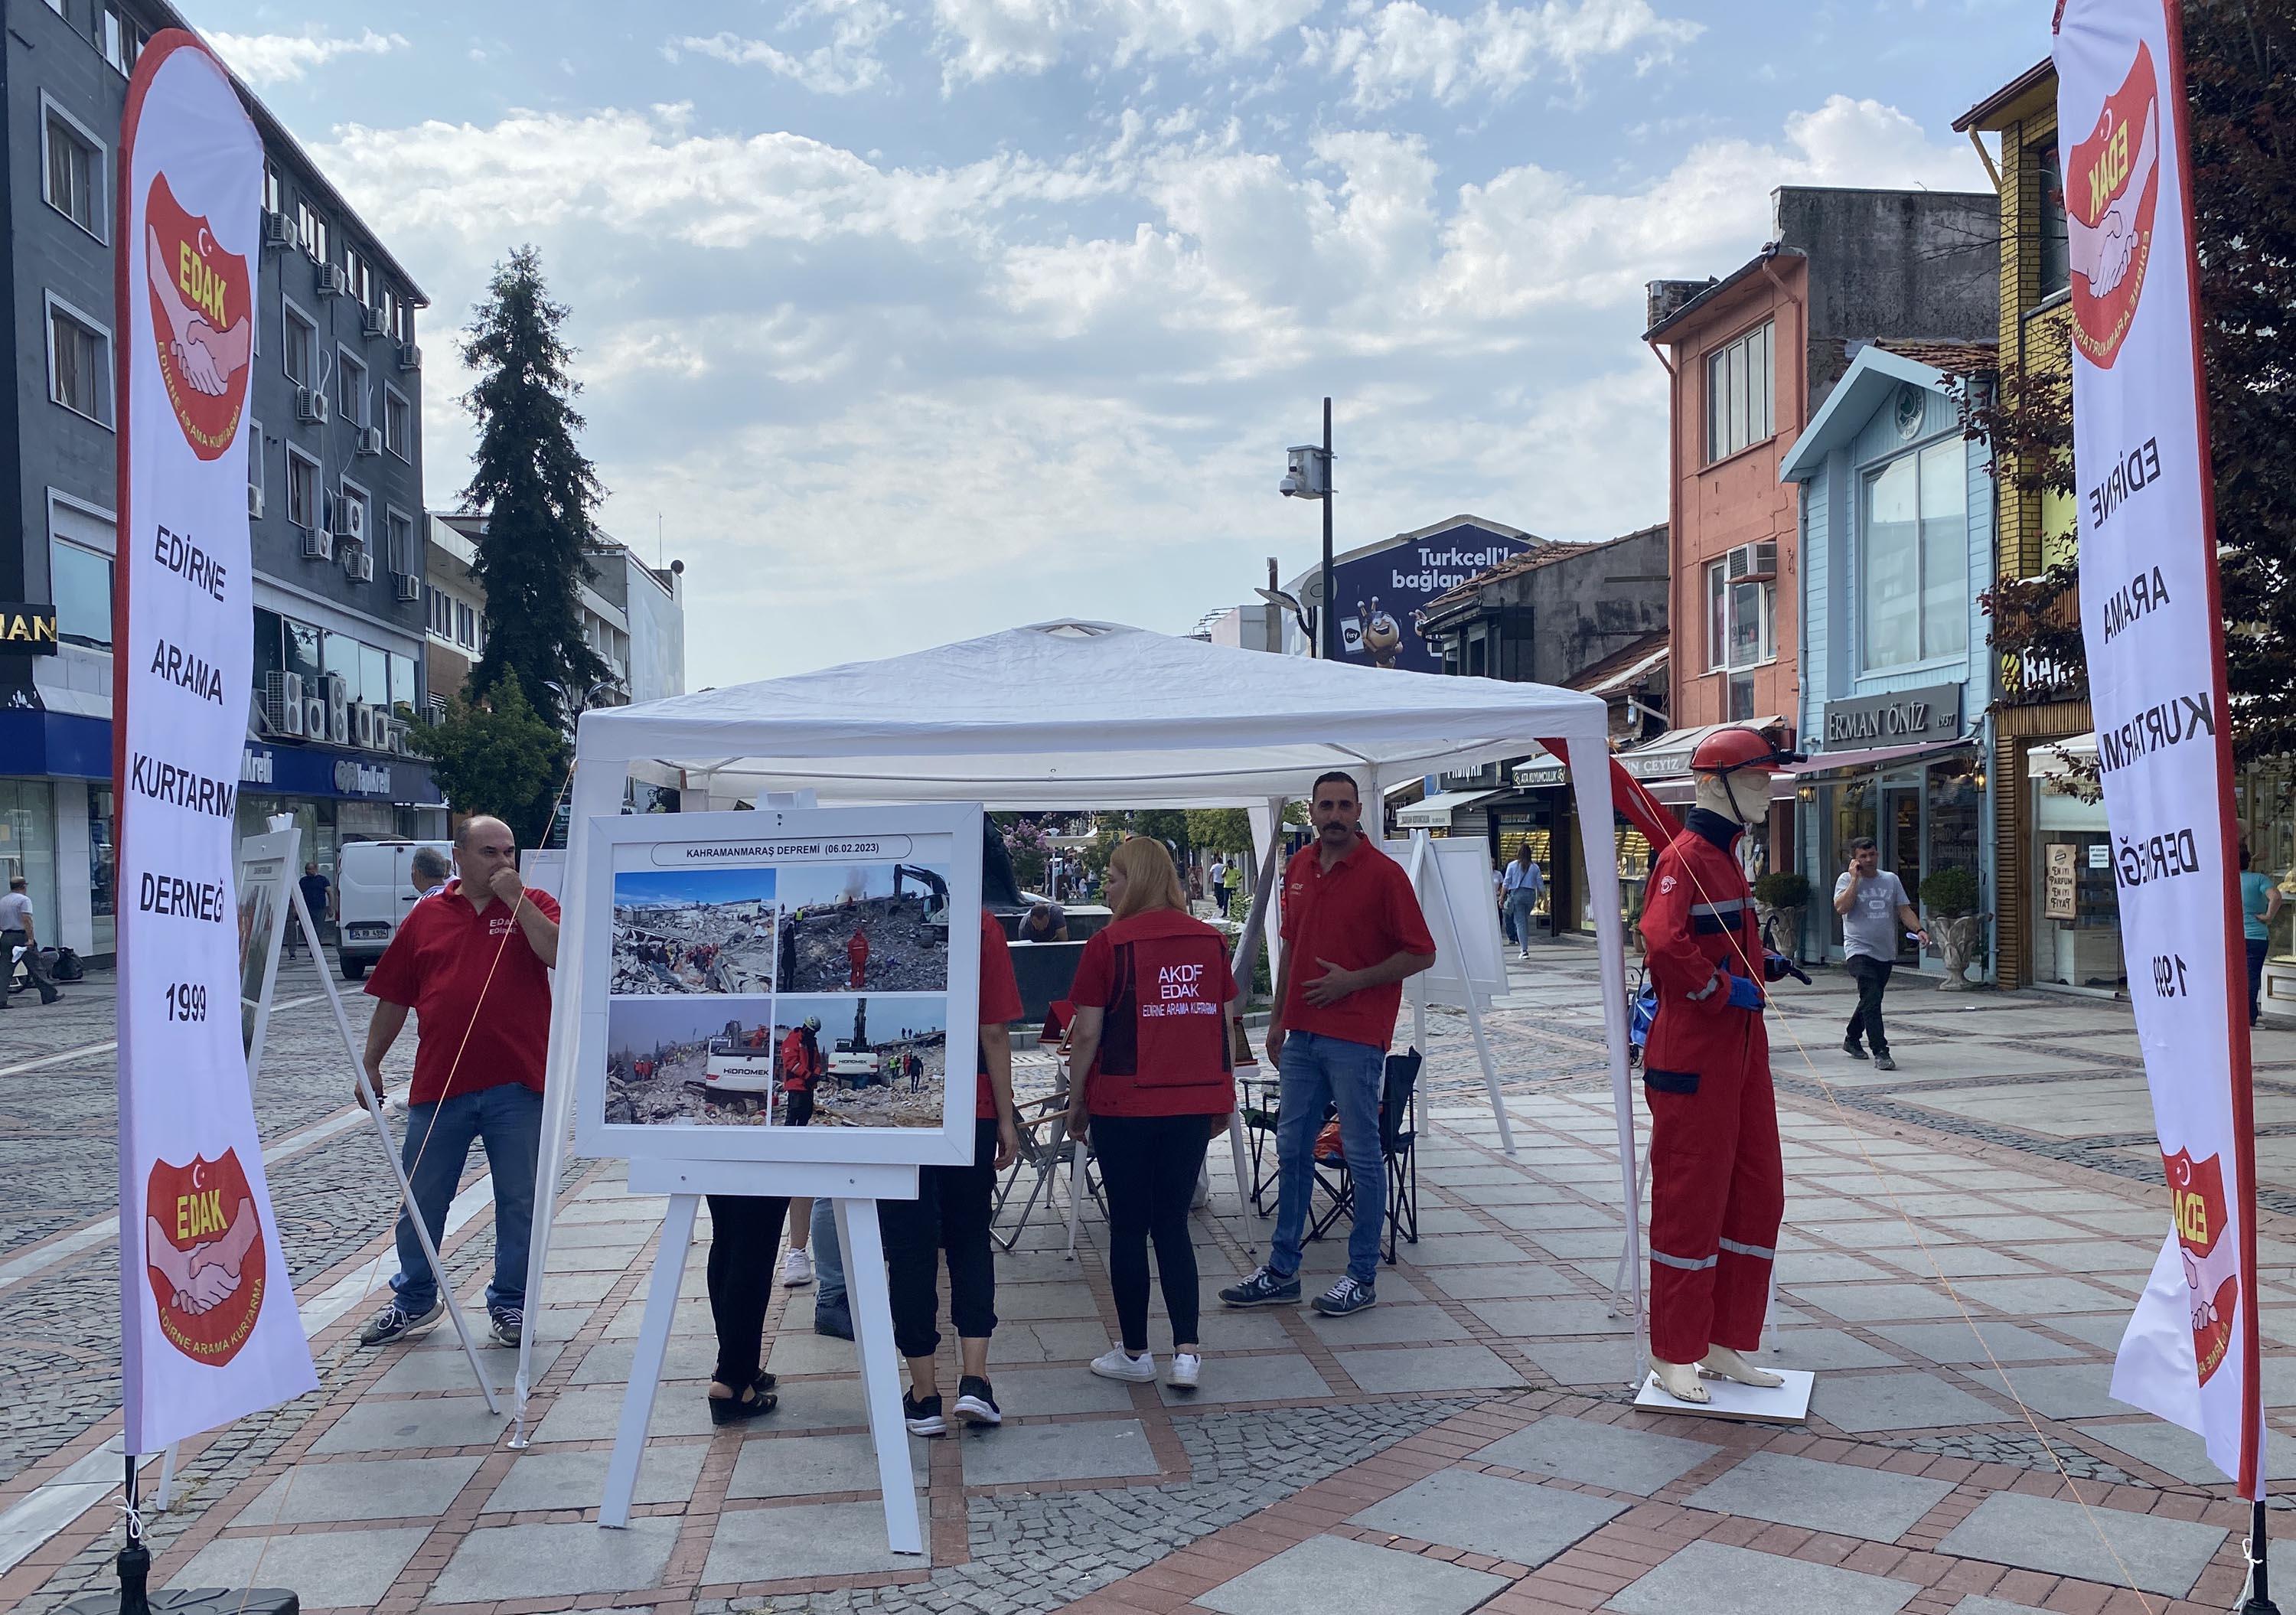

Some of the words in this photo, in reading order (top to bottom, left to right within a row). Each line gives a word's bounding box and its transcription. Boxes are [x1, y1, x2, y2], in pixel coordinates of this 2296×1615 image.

[179, 239, 227, 328] EDAK
[180, 409, 208, 447] ARAMA
[155, 524, 226, 602] EDİRNE
[151, 639, 223, 706] ARAMA
[1828, 710, 1882, 741] ERMAN
[1887, 701, 1926, 735] ÖNİZ
[1937, 713, 1955, 727] 1937
[1643, 757, 1679, 775] ÇEYİZ
[687, 847, 775, 858] KAHRAMANMARAŞ
[777, 843, 820, 855] DEPREMİ
[824, 843, 879, 855] (06.02.2023)
[140, 872, 224, 924] DERNEĞ
[1158, 964, 1203, 984] AKDF
[1161, 984, 1200, 999] EDAK
[165, 983, 207, 1022] 1999
[1166, 1002, 1189, 1016] ARAMA
[177, 1189, 227, 1240] EDAK
[193, 1339, 230, 1355] ARAMA
[230, 1278, 262, 1345] KURTARMA
